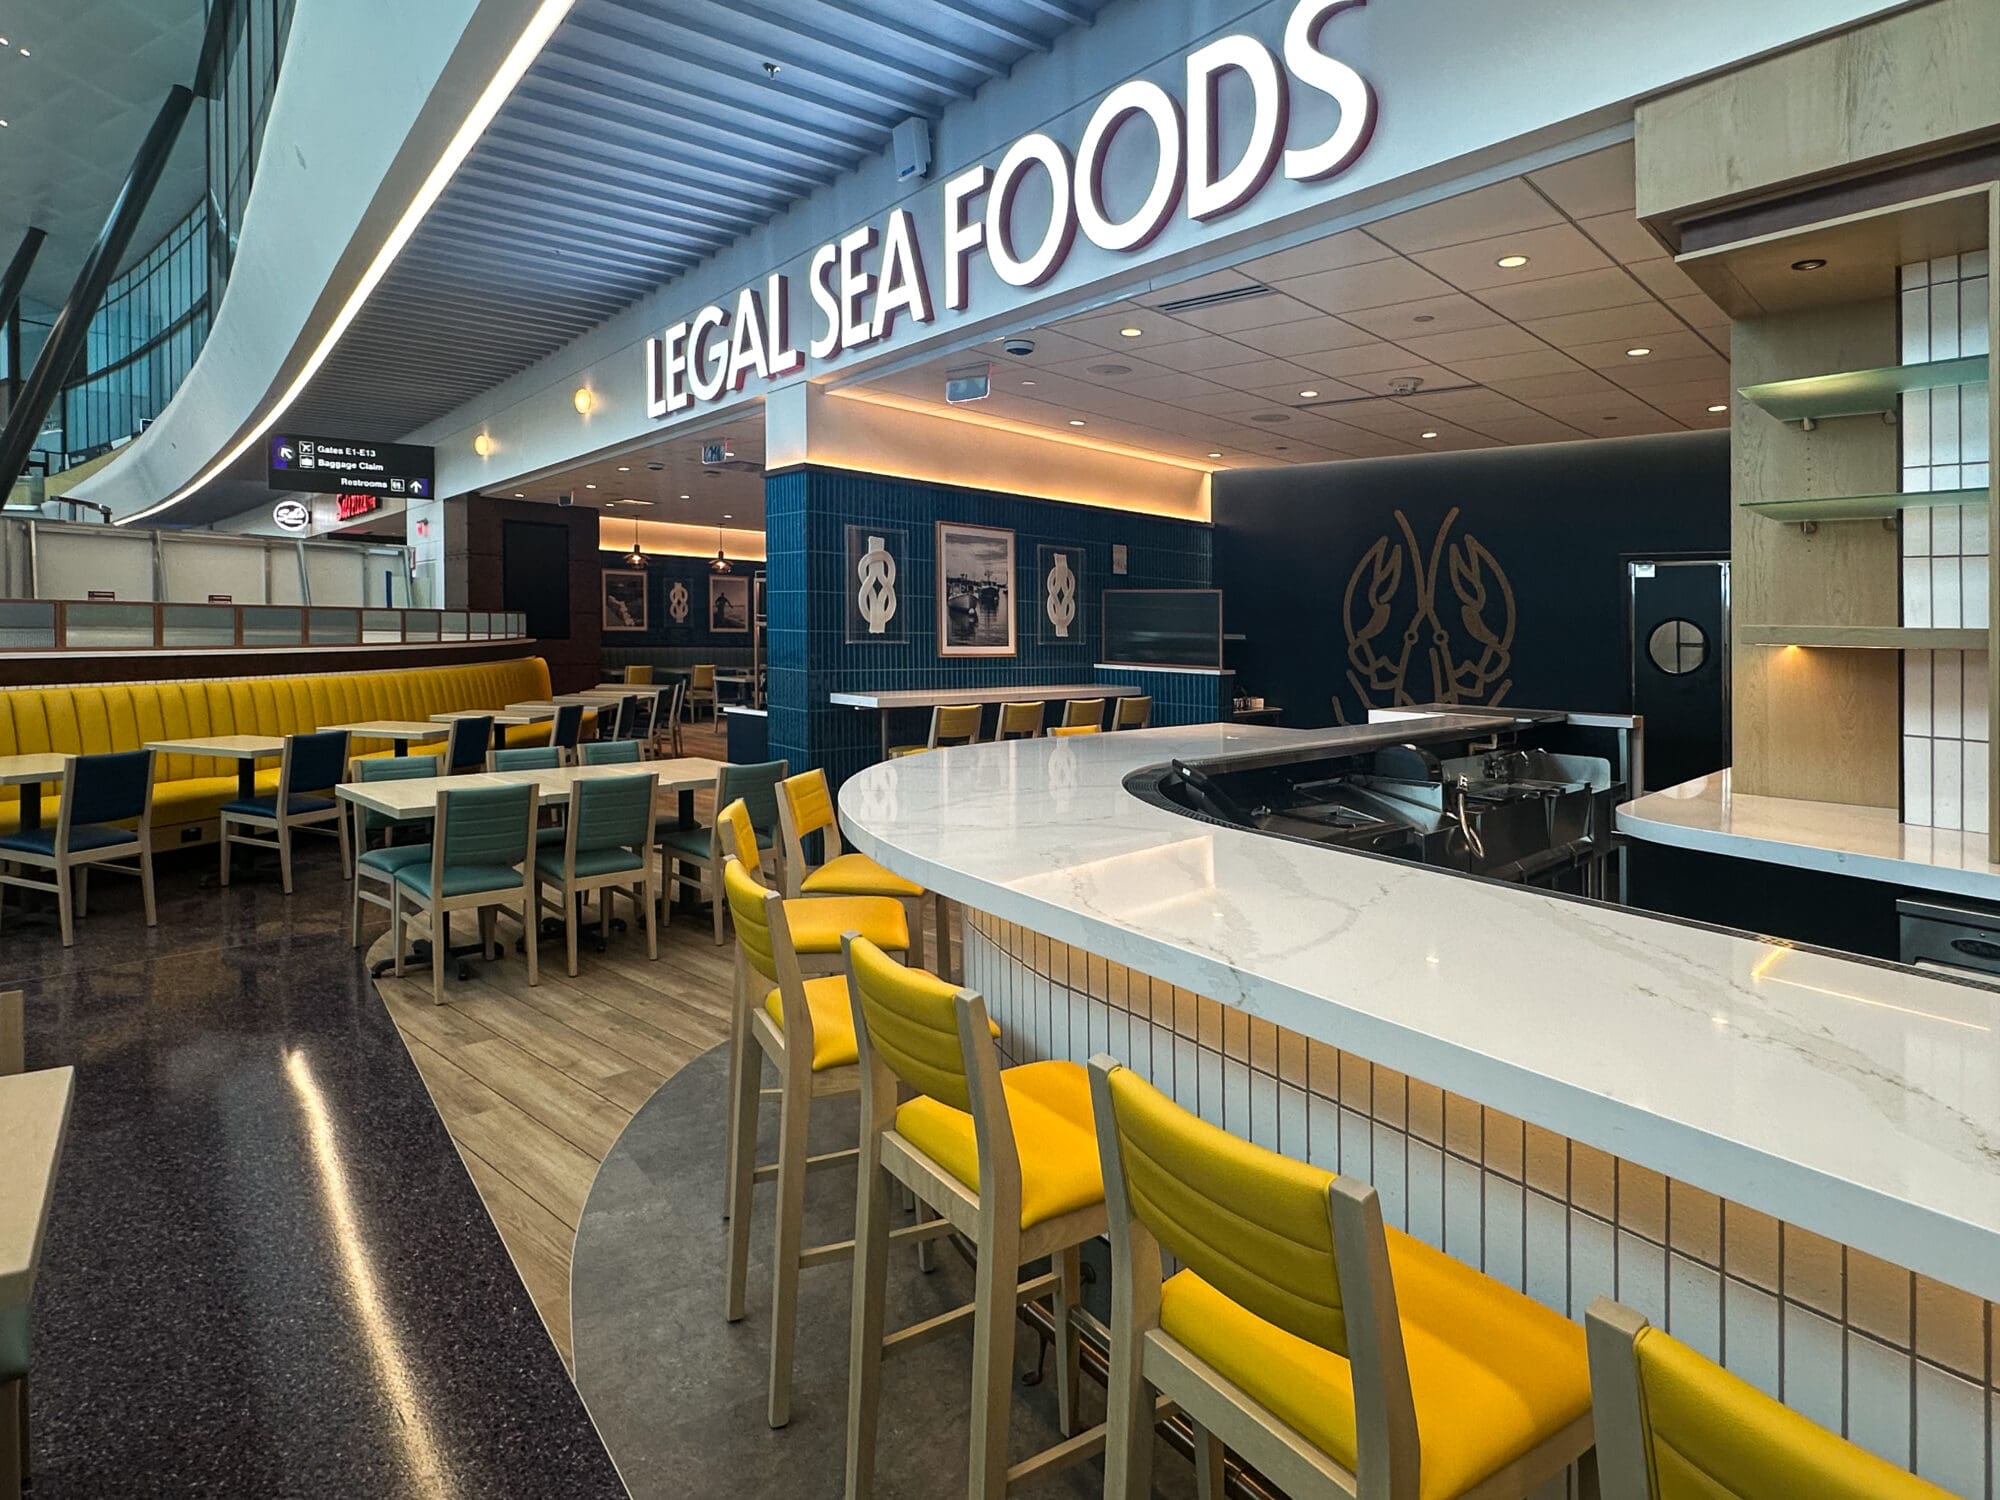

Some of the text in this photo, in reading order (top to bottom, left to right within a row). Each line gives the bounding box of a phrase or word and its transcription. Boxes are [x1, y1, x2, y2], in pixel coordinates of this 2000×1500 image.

[647, 0, 1372, 419] LEGAL SEA FOODS
[317, 445, 377, 457] Gates E1-E13
[318, 459, 384, 471] Baggage Claim
[340, 477, 388, 488] Restrooms
